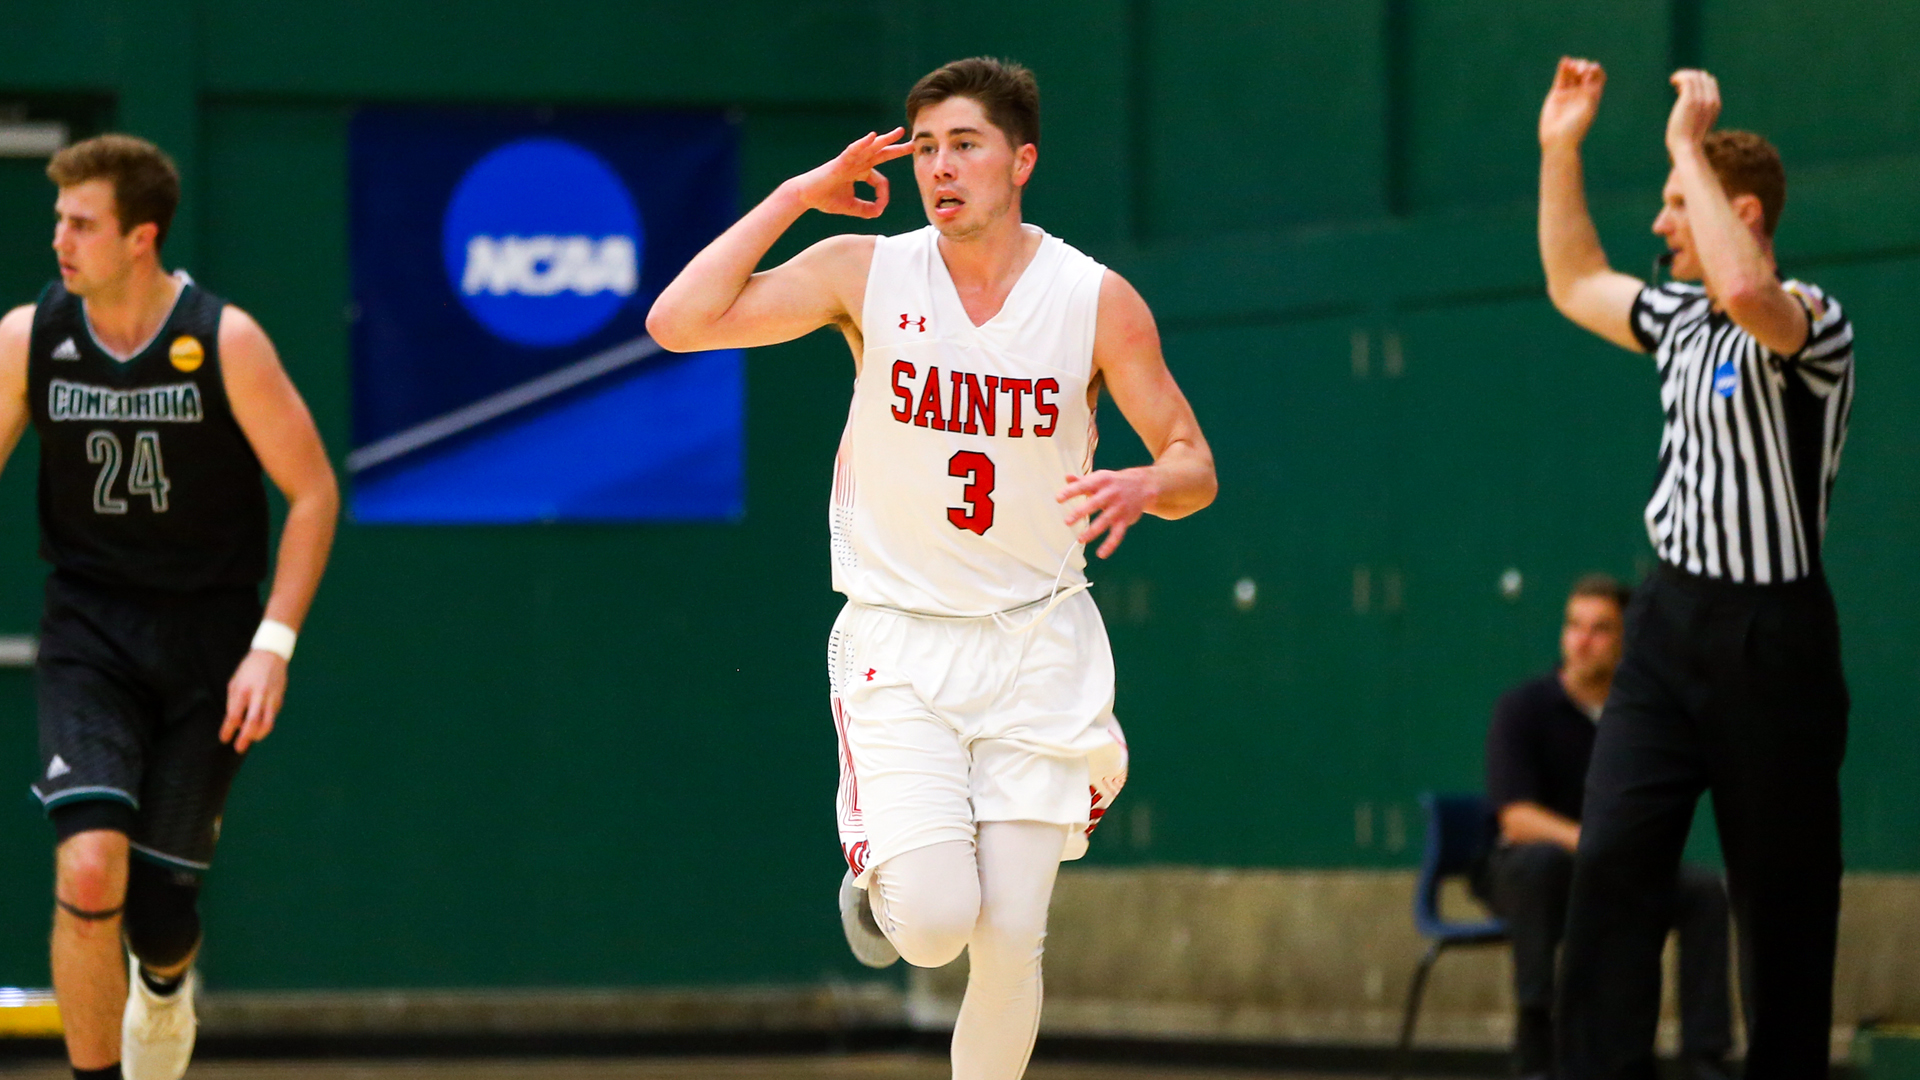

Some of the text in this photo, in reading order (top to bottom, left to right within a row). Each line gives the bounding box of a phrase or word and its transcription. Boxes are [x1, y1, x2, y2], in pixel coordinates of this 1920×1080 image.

[461, 234, 639, 297] NCAA
[49, 379, 203, 422] CONCORDIA
[891, 359, 1060, 438] SAINTS
[86, 429, 170, 514] 24
[947, 450, 995, 536] 3
